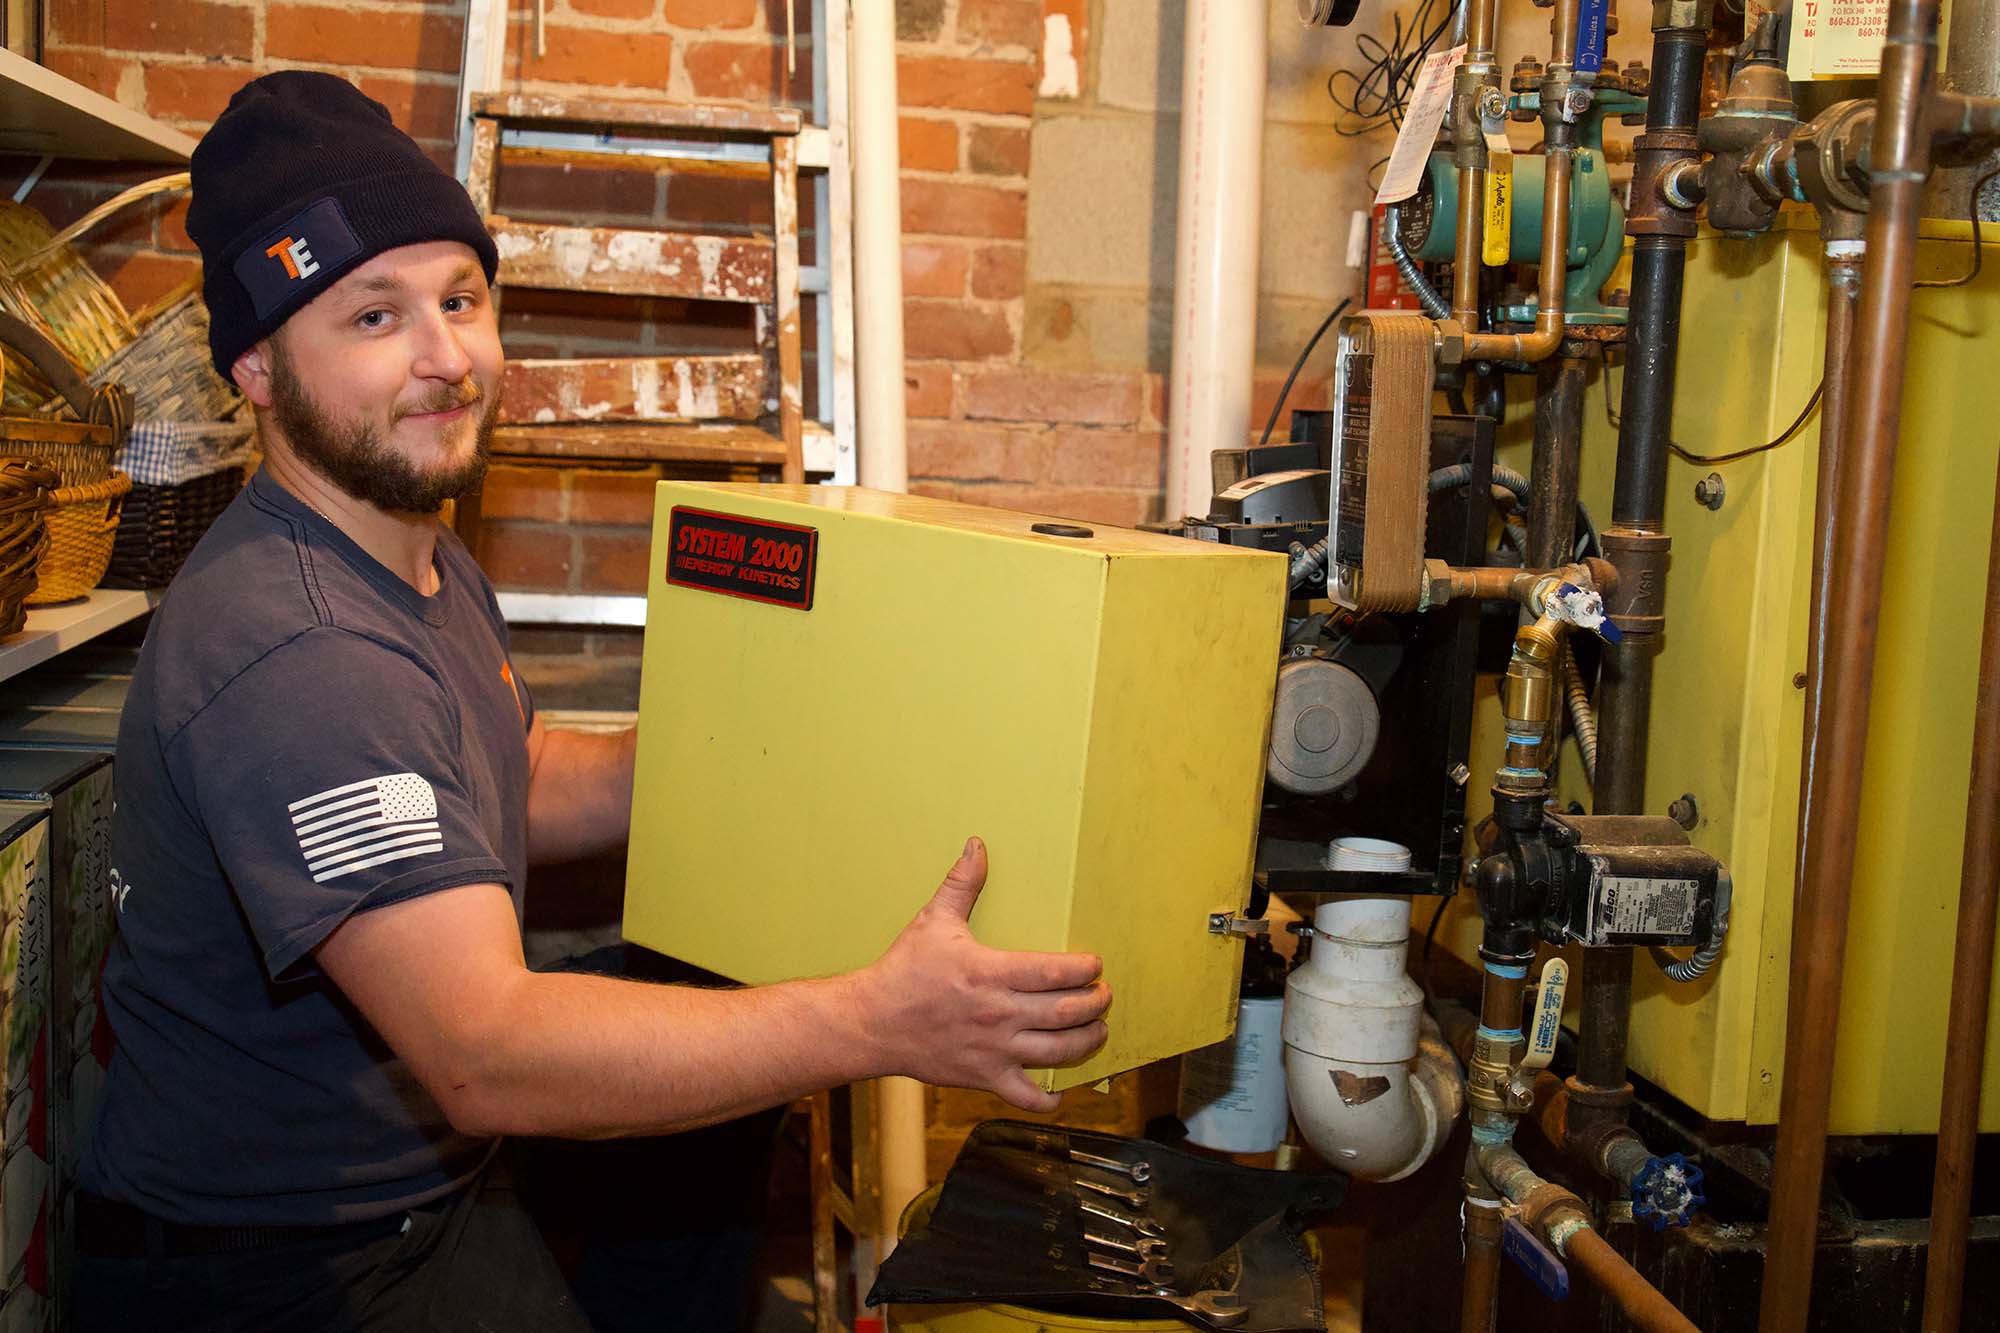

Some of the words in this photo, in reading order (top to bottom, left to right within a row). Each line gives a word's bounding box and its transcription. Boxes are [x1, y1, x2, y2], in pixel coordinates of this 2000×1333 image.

[1829, 16, 1882, 26] 860-623-3308
[1494, 180, 1506, 207] Apollo
[265, 235, 320, 280] TE
[677, 525, 746, 564] SYSTEM
[749, 537, 803, 572] 2000
[684, 556, 736, 578] ENERGY
[738, 567, 800, 589] KINETICS
[24, 858, 40, 1003] HOME
